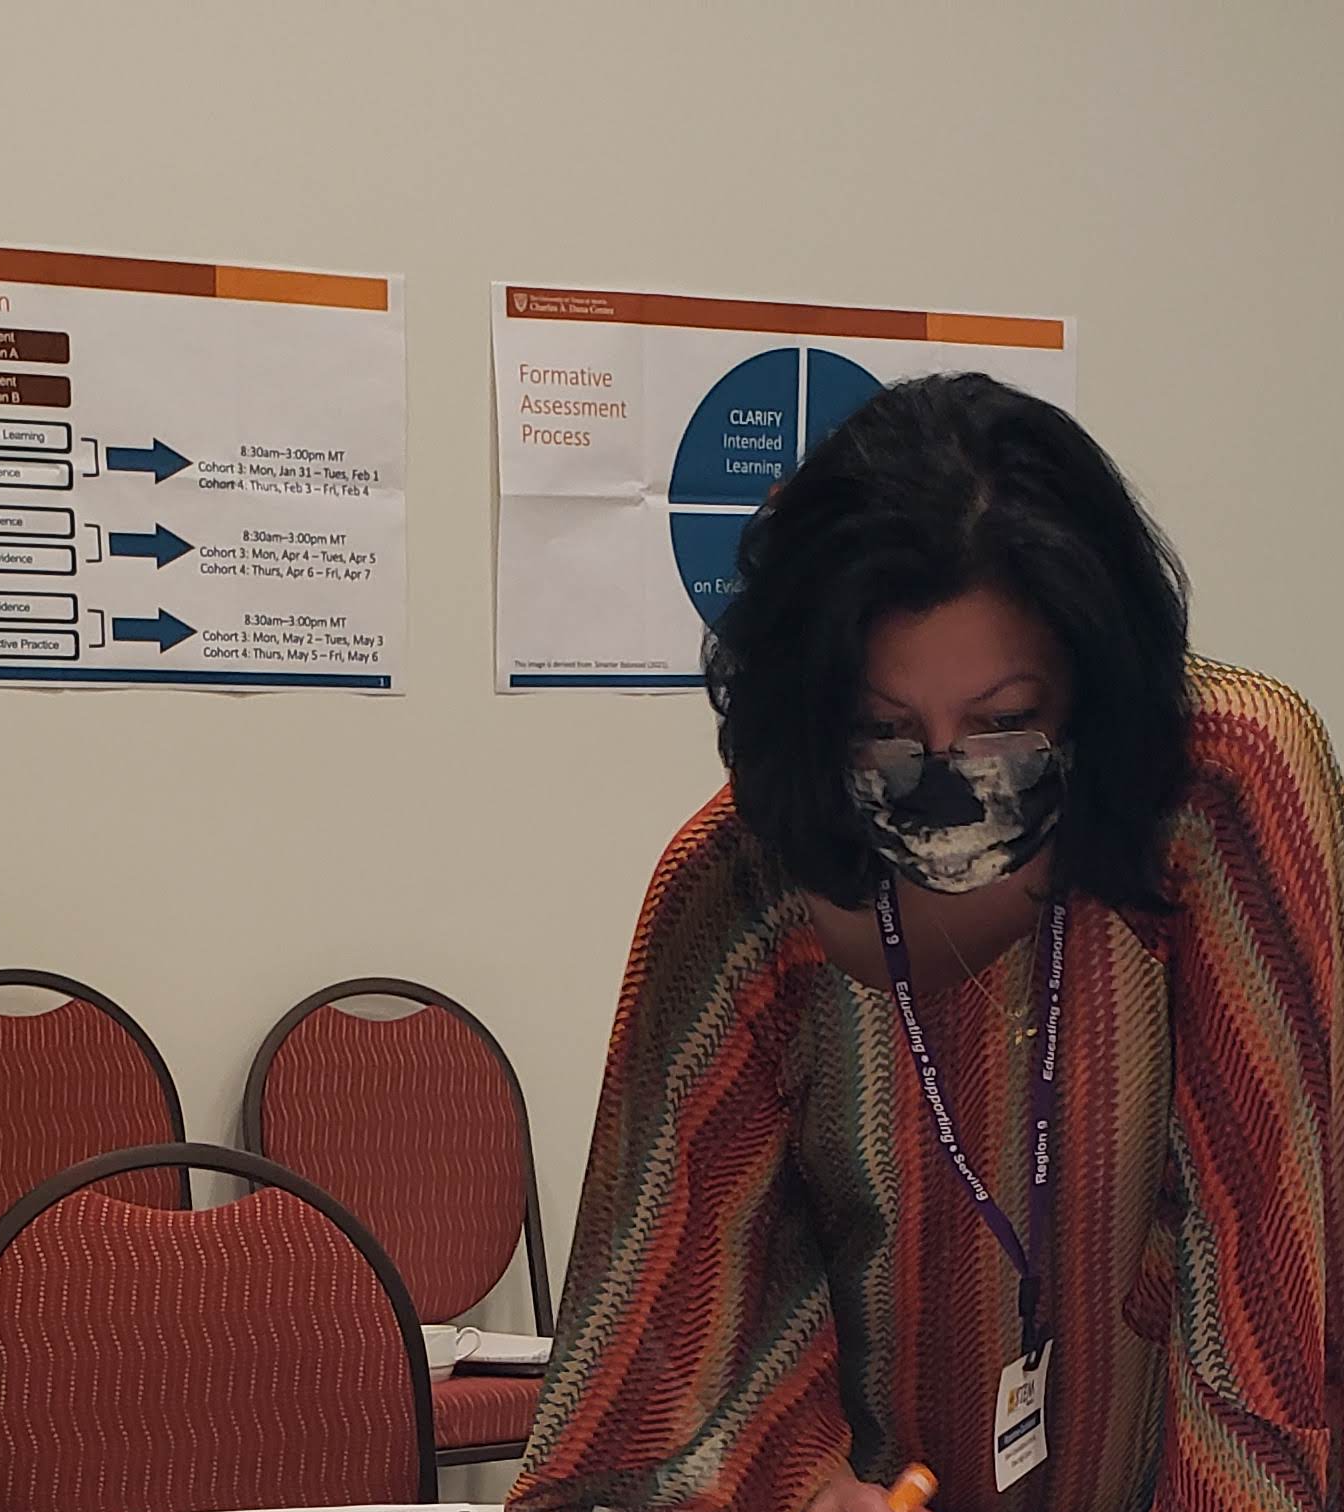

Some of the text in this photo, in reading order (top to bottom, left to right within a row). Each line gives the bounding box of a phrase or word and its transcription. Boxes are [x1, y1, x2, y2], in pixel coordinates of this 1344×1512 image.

[8, 348, 18, 359] A
[519, 363, 613, 388] Formative
[520, 394, 627, 419] Assessment
[729, 407, 783, 427] CLARIFY
[3, 430, 45, 443] Learning
[522, 423, 591, 447] Process
[722, 433, 783, 452] Intended
[328, 451, 345, 462] MT
[198, 461, 379, 481] Cohort 3: Mon, Jan 31 Tues, Feb 1
[726, 457, 782, 479] Learning
[199, 477, 235, 490] Cohort
[250, 481, 282, 494] Thurs,
[285, 482, 303, 493] Feb
[305, 483, 312, 494] 3
[323, 484, 340, 496] Fri,
[342, 485, 360, 496] Feb
[362, 486, 369, 496] 4
[694, 581, 712, 593] on
[330, 617, 346, 628] MT
[20, 639, 59, 650] Practice
[203, 630, 383, 648] Cohort 3: Mon, May 2 Tues, May 3
[886, 934, 899, 944] 9
[1042, 904, 1066, 1081] Educating Supporting
[894, 980, 988, 1202] Educating Supporting Serving
[1035, 1120, 1050, 1184] Region 9
